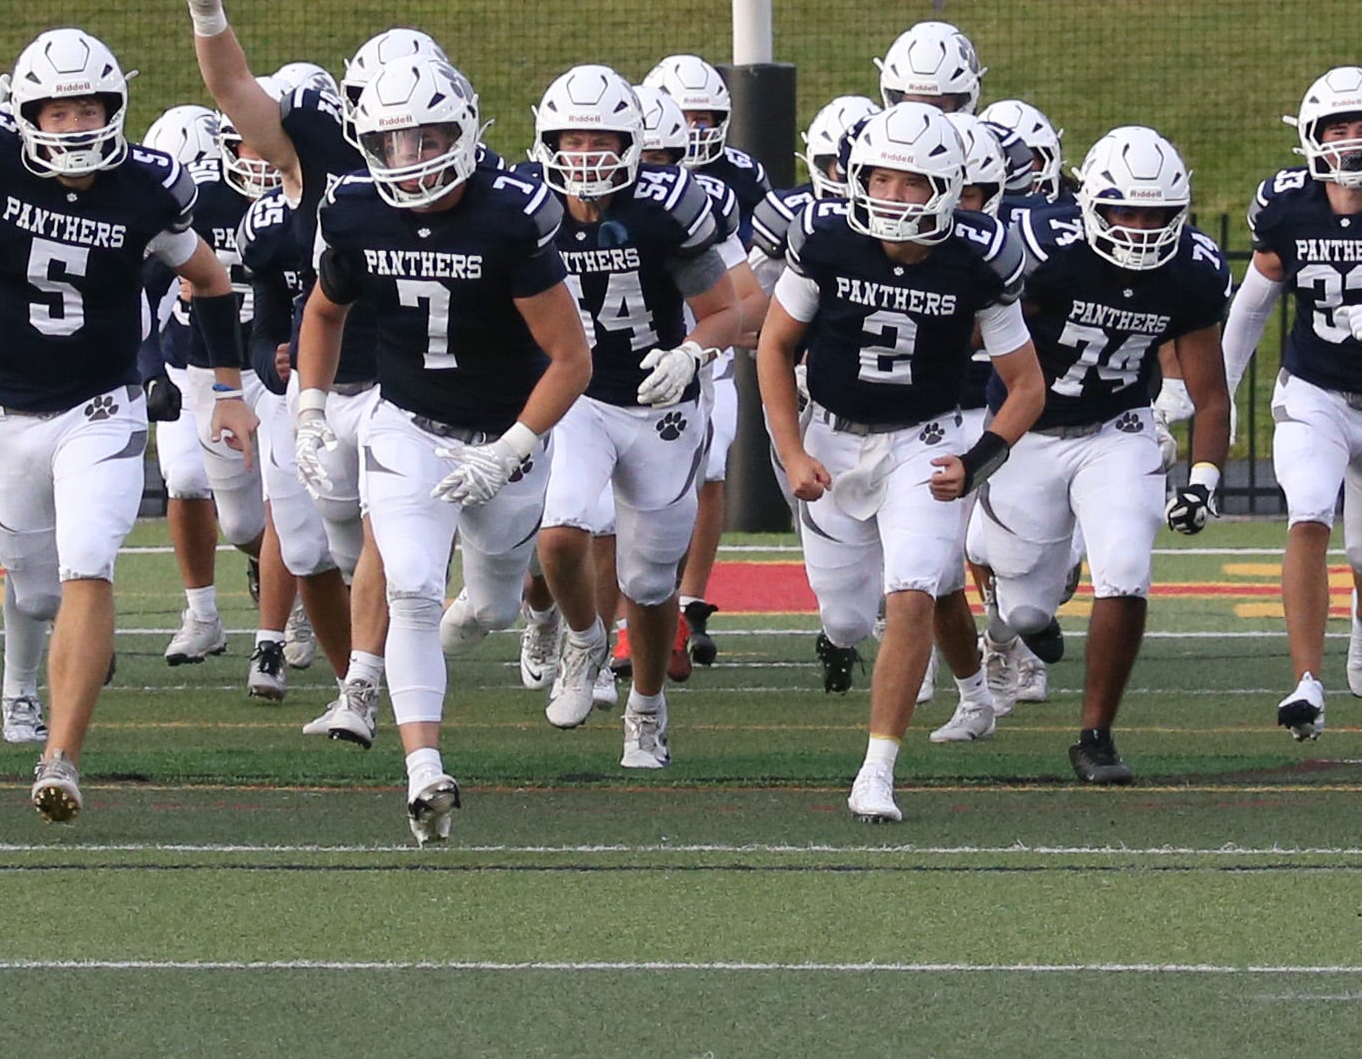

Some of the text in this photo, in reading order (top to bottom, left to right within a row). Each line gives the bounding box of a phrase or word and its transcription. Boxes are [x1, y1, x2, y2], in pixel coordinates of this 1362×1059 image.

[56, 83, 91, 93] Riddell
[379, 116, 413, 127] Riddell
[634, 171, 676, 201] 54
[3, 196, 127, 249] PANTHERS
[955, 223, 992, 245] 2
[364, 249, 483, 279] PANTHERS
[559, 248, 641, 273] NTHERS
[27, 237, 90, 337] 5
[836, 277, 957, 316] PANTHERS
[396, 279, 459, 369] 7
[1069, 300, 1171, 333] PANTHERS
[858, 310, 918, 385] 2
[1051, 321, 1158, 397] 74
